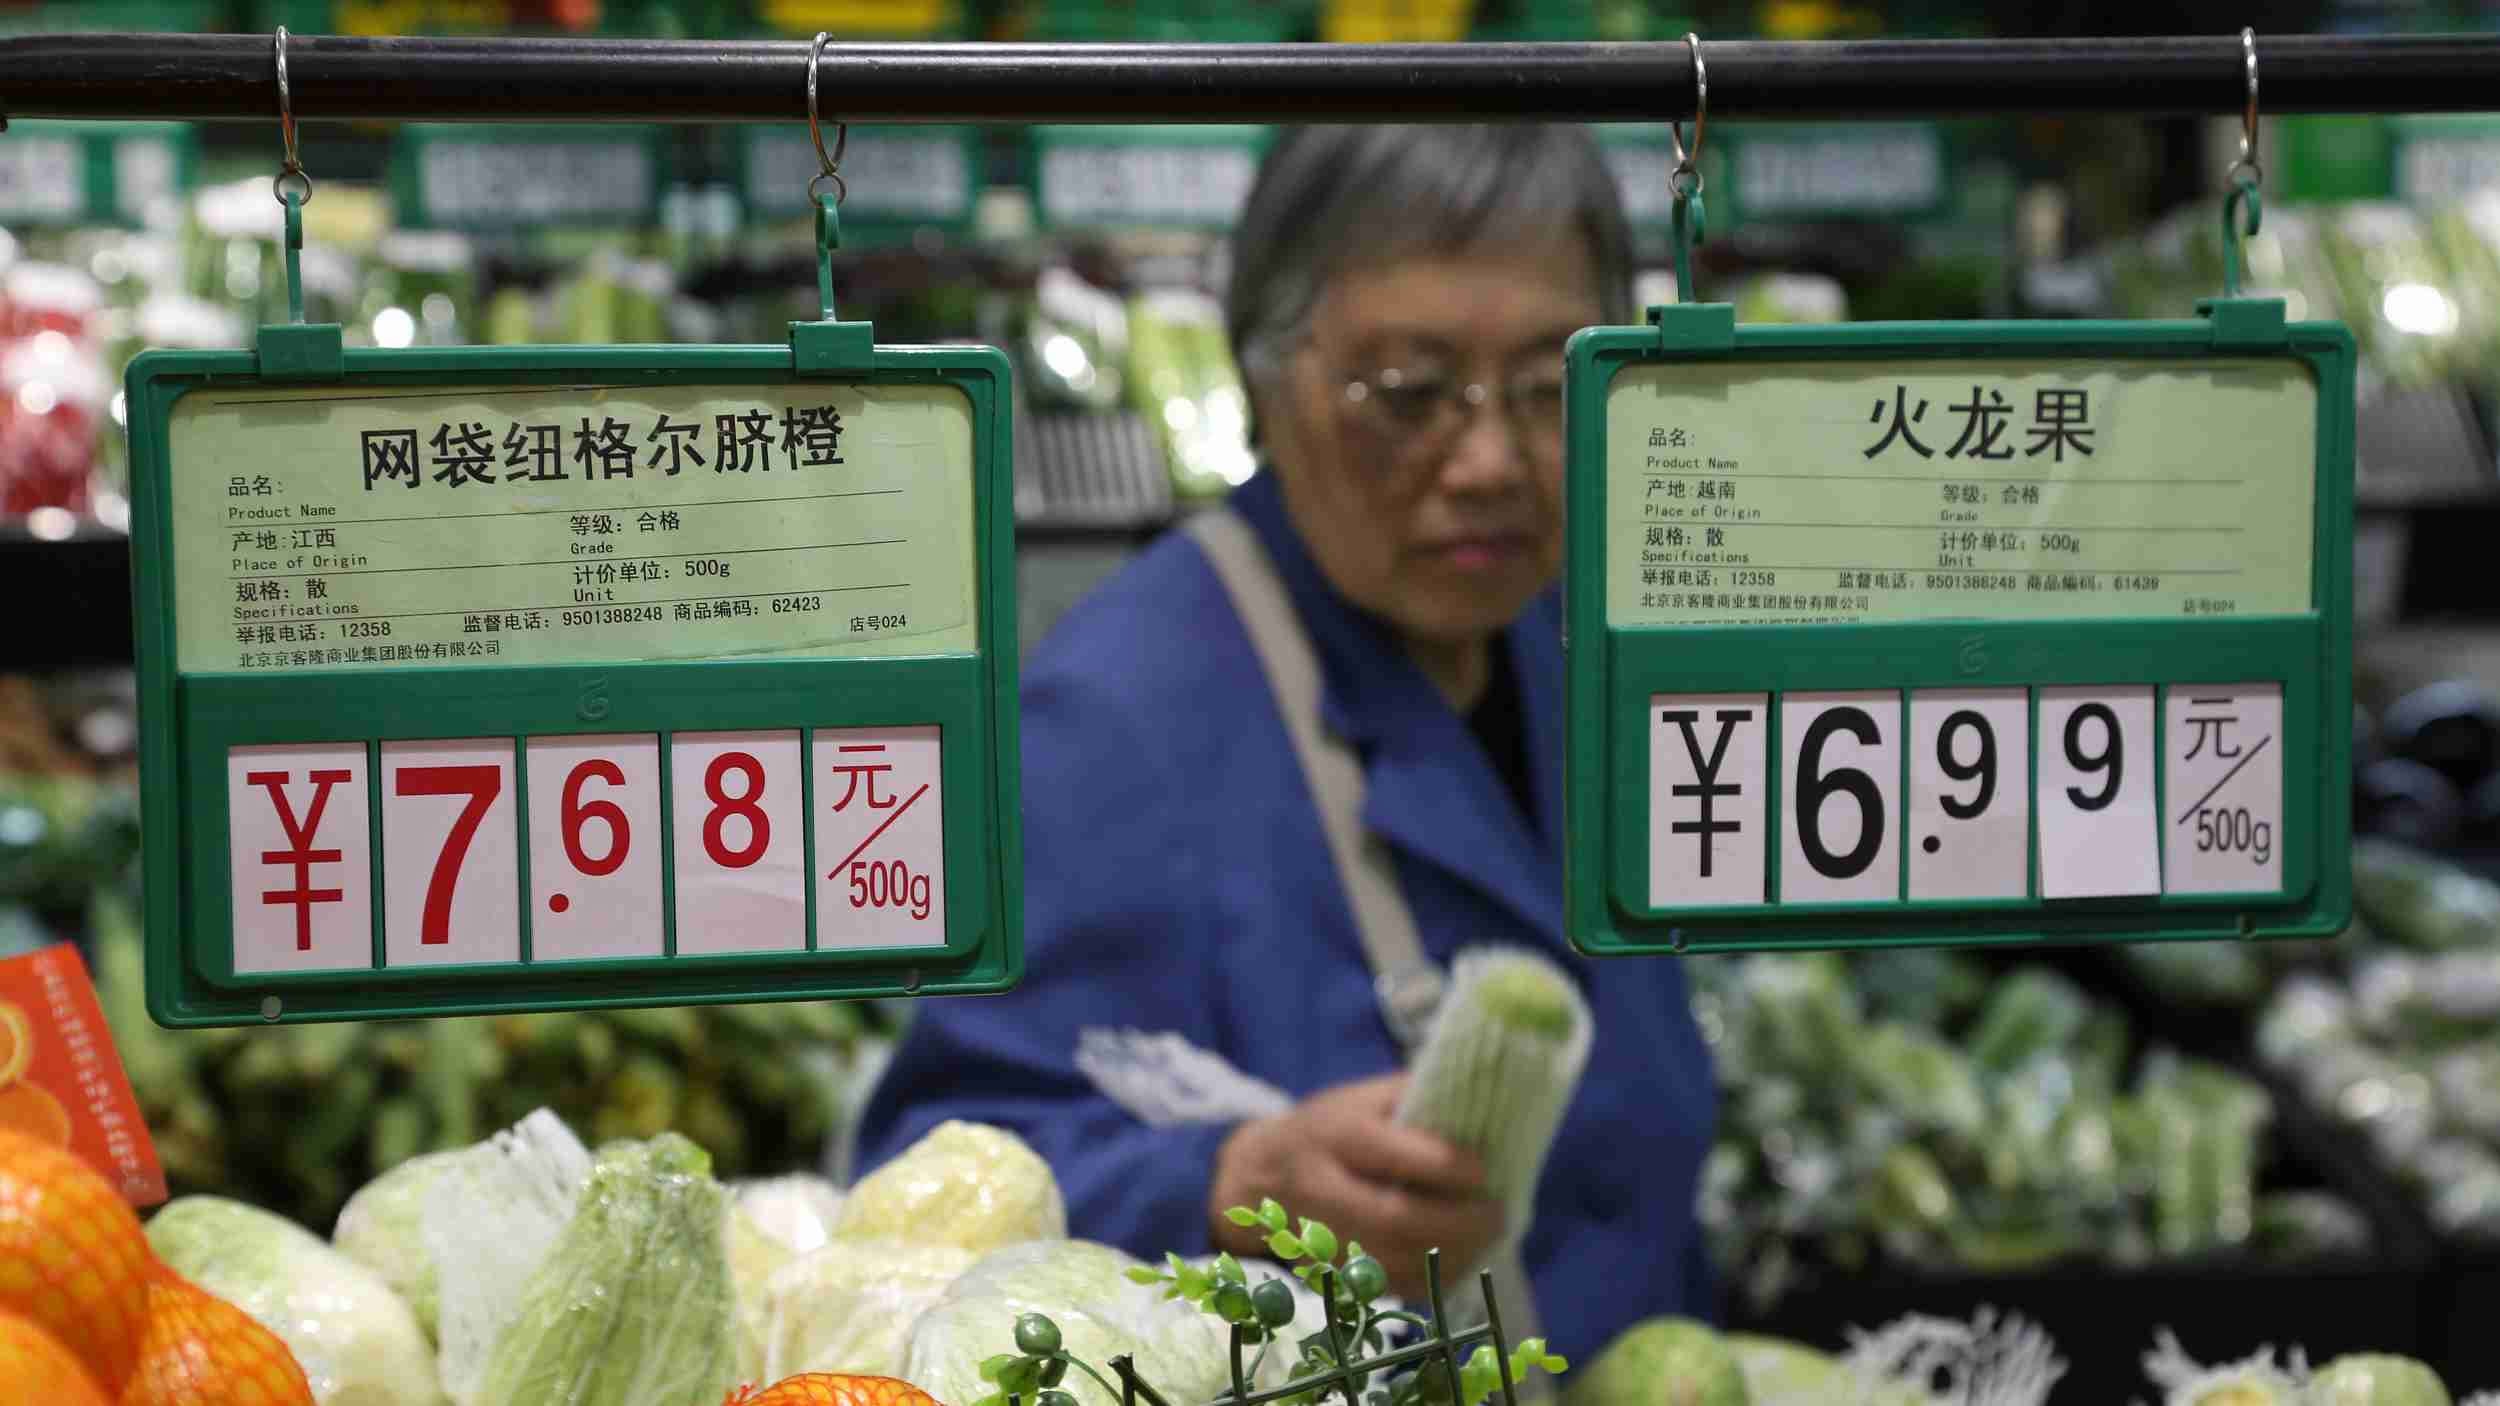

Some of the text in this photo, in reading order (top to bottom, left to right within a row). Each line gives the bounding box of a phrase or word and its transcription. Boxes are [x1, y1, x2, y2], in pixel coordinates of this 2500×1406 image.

[1863, 384, 2096, 462] 火龙果
[360, 405, 844, 491] 网袋纽格尔脐橙
[1647, 456, 1738, 470] Product Name
[228, 475, 284, 497] 品名:
[228, 504, 336, 520] Product Name
[1645, 505, 1761, 521] Place of Origin
[570, 541, 614, 555] Grade
[232, 553, 367, 572] Place of Origin
[1641, 551, 1749, 565] Specifications
[1939, 554, 1974, 569] Unit
[574, 588, 614, 602] Unit
[233, 602, 360, 621] Specifications
[850, 614, 907, 633] 店号024
[239, 639, 501, 669] 北京京客隆商业集团股份有限公司
